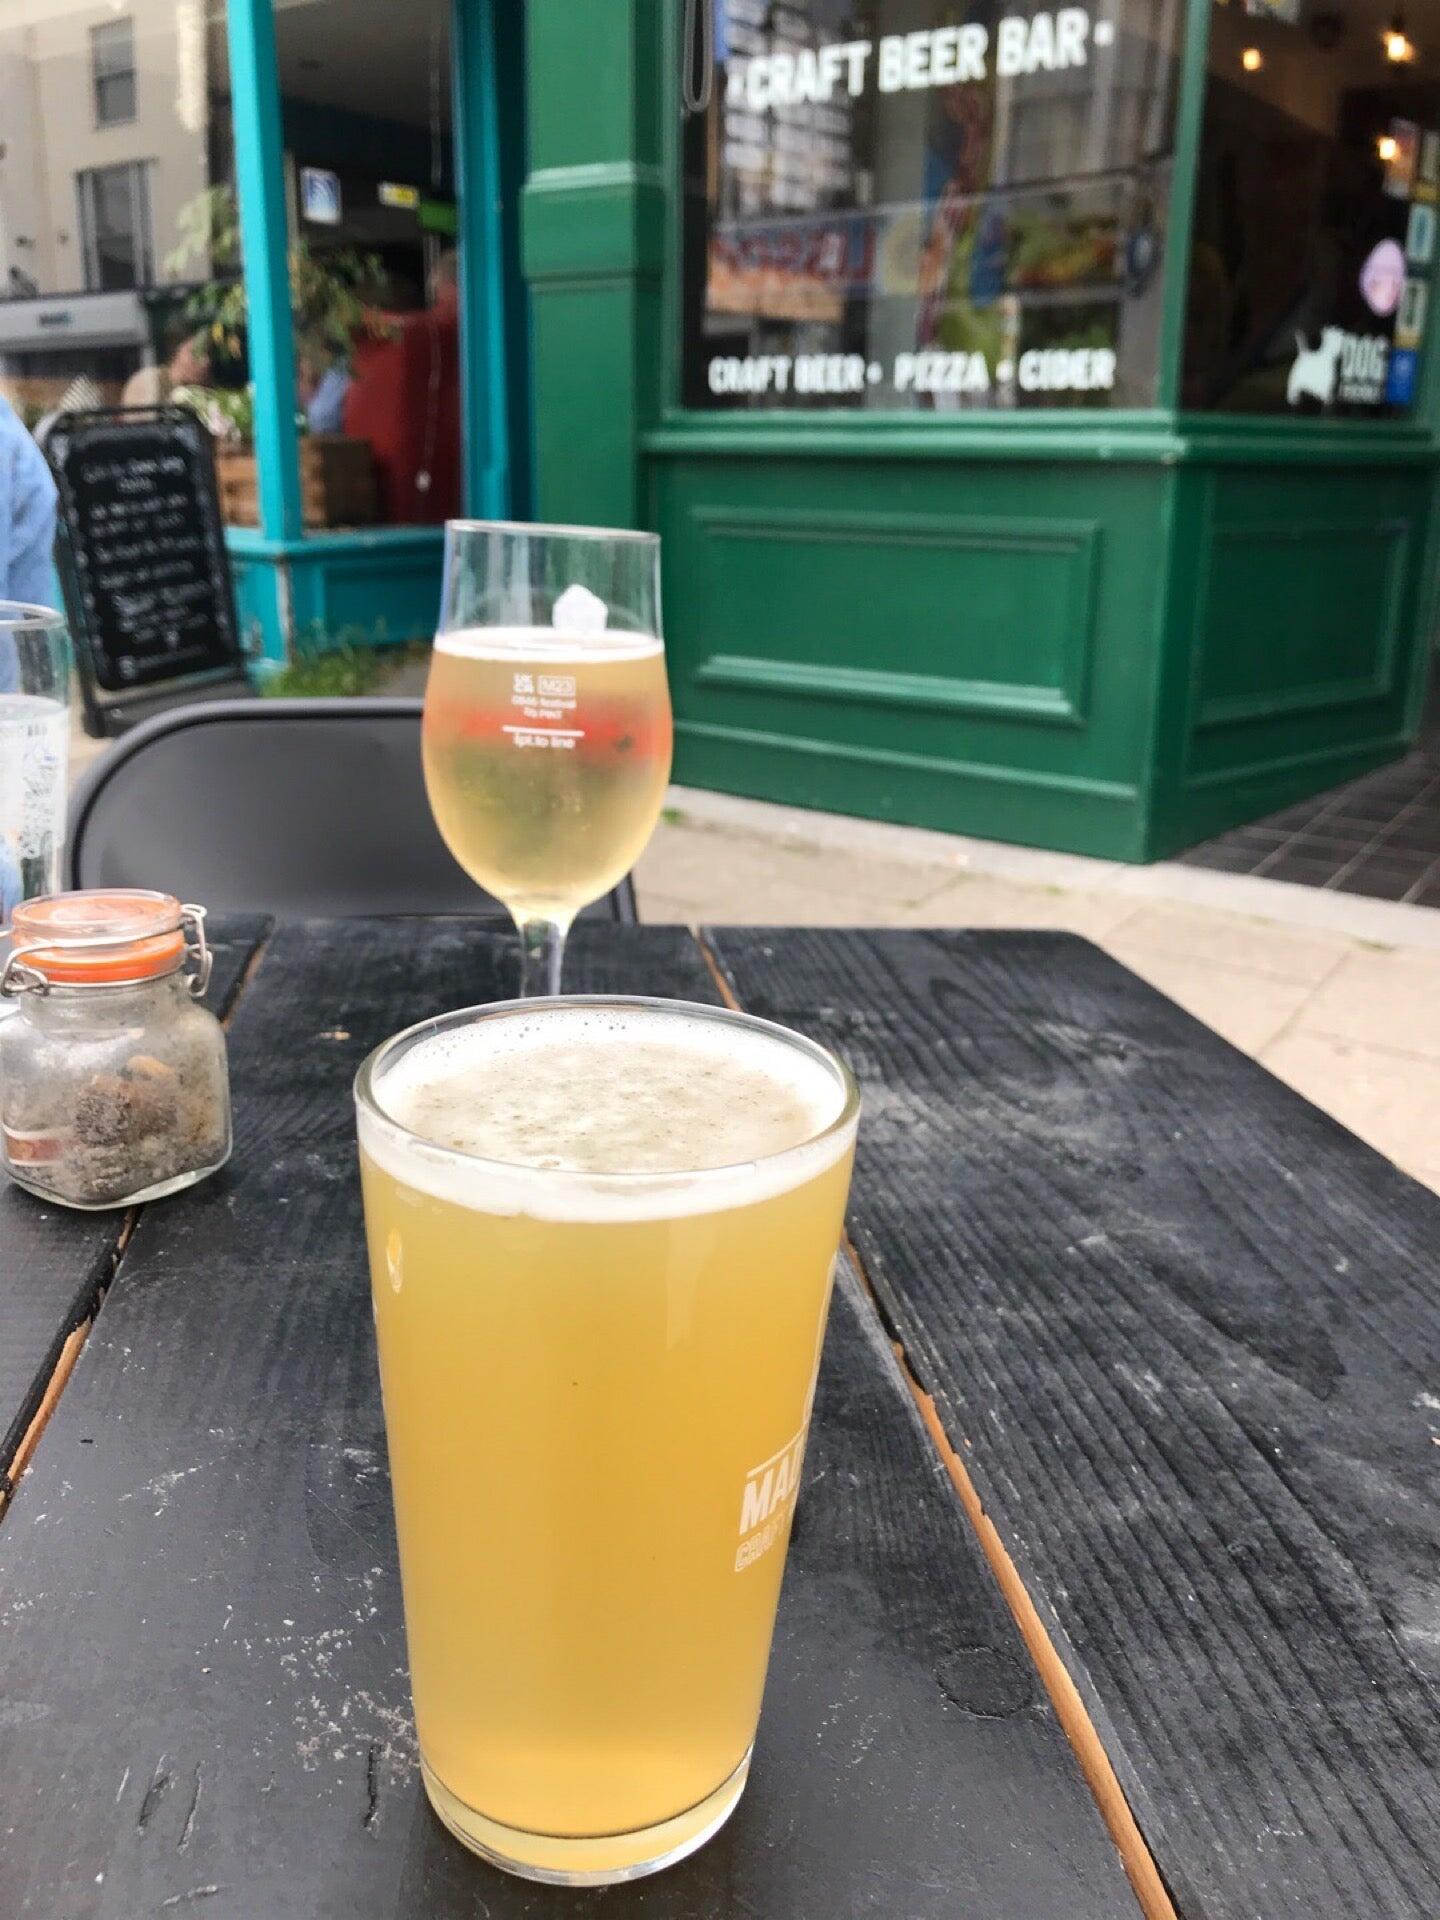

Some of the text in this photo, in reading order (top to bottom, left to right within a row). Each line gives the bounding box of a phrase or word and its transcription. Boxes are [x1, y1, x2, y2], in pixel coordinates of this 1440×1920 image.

[744, 7, 1090, 110] CRAFT BEER BAR
[708, 349, 1117, 393] CRAFT BEER PIZZA CIDER
